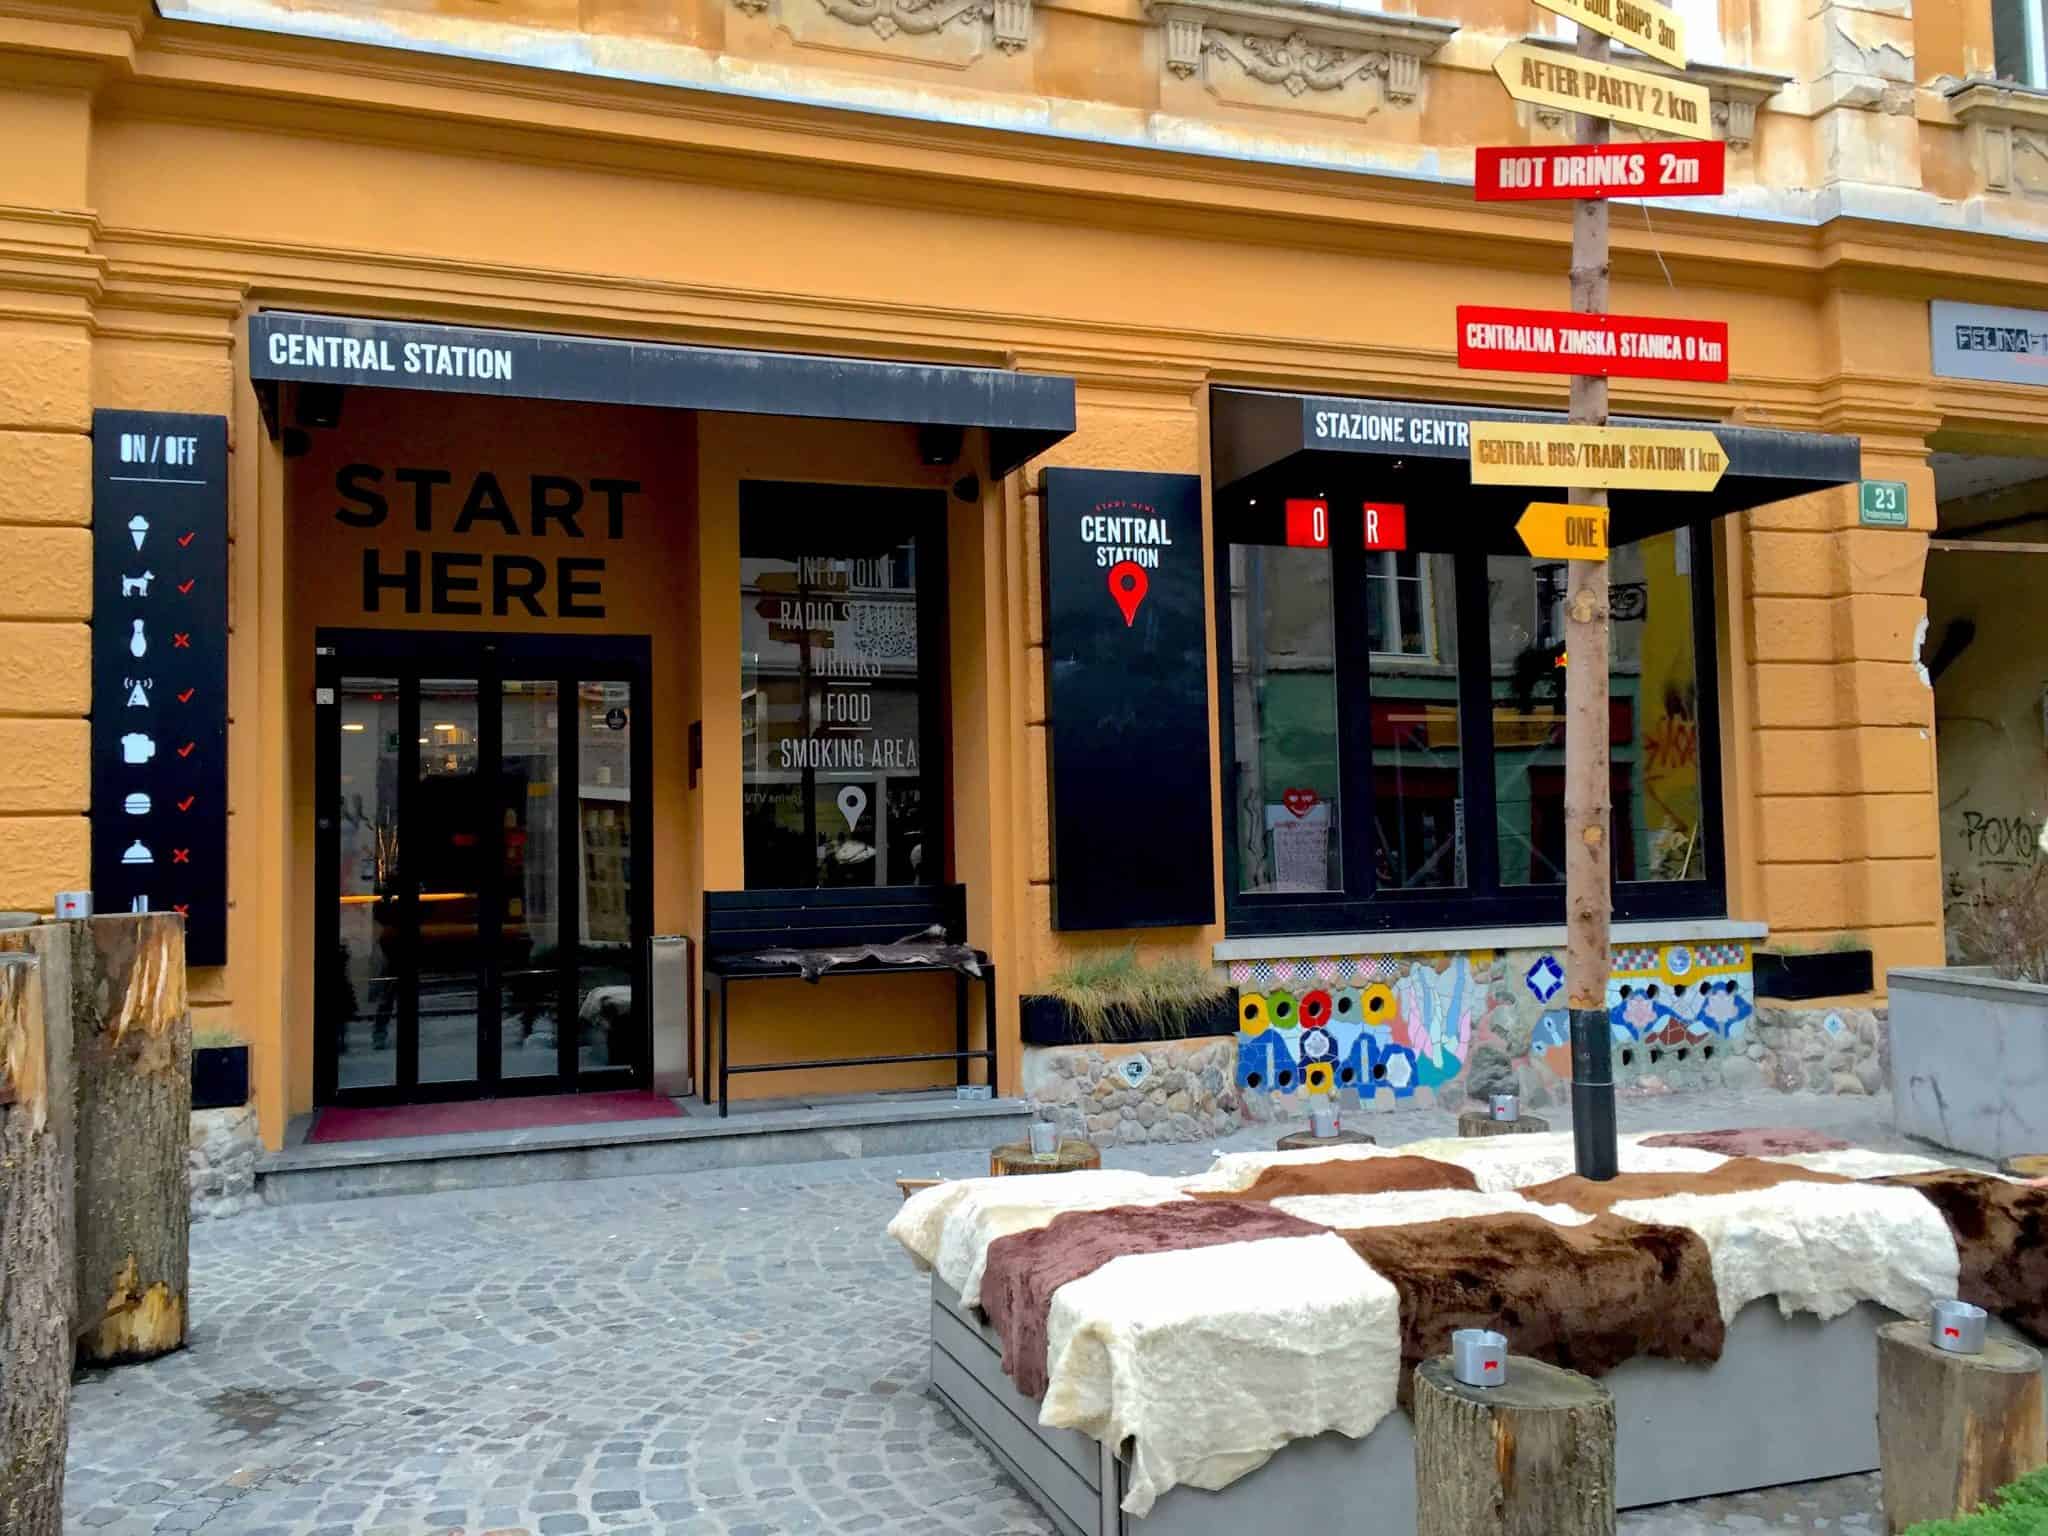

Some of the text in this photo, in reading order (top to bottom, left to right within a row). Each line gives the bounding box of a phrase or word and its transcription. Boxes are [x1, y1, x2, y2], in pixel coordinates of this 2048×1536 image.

[1616, 0, 1652, 40] SHOPS
[1658, 18, 1676, 51] 3m
[1521, 57, 1698, 124] AFTER PARTY 2 km
[1499, 153, 1700, 188] HOT DRINKS 2m
[269, 332, 512, 381] CENTRAL STATION
[1466, 323, 1555, 353] CENTRALNA
[1559, 329, 1617, 357] ZIMSKA
[1620, 332, 1682, 361] STANICA
[1699, 337, 1722, 363] km
[1315, 411, 1405, 443] STAZIONE
[121, 433, 146, 463] ON
[165, 436, 197, 465] OFF
[1479, 439, 1544, 467] CENTRAL
[1548, 441, 1625, 471] BUS/TRAIN
[1629, 445, 1686, 472] STATION
[1699, 447, 1720, 473] km
[334, 463, 641, 540] START
[1875, 487, 1896, 510] 23
[1080, 515, 1172, 545] CENTRAL
[1366, 509, 1379, 544] R
[1565, 516, 1597, 548] ONE
[1096, 546, 1159, 569] STATION
[362, 548, 607, 619] HERE
[780, 601, 834, 631] RADIO
[815, 648, 882, 678] DRINKS
[827, 693, 872, 723] FOOD
[780, 738, 918, 769] SMOKING AREA
